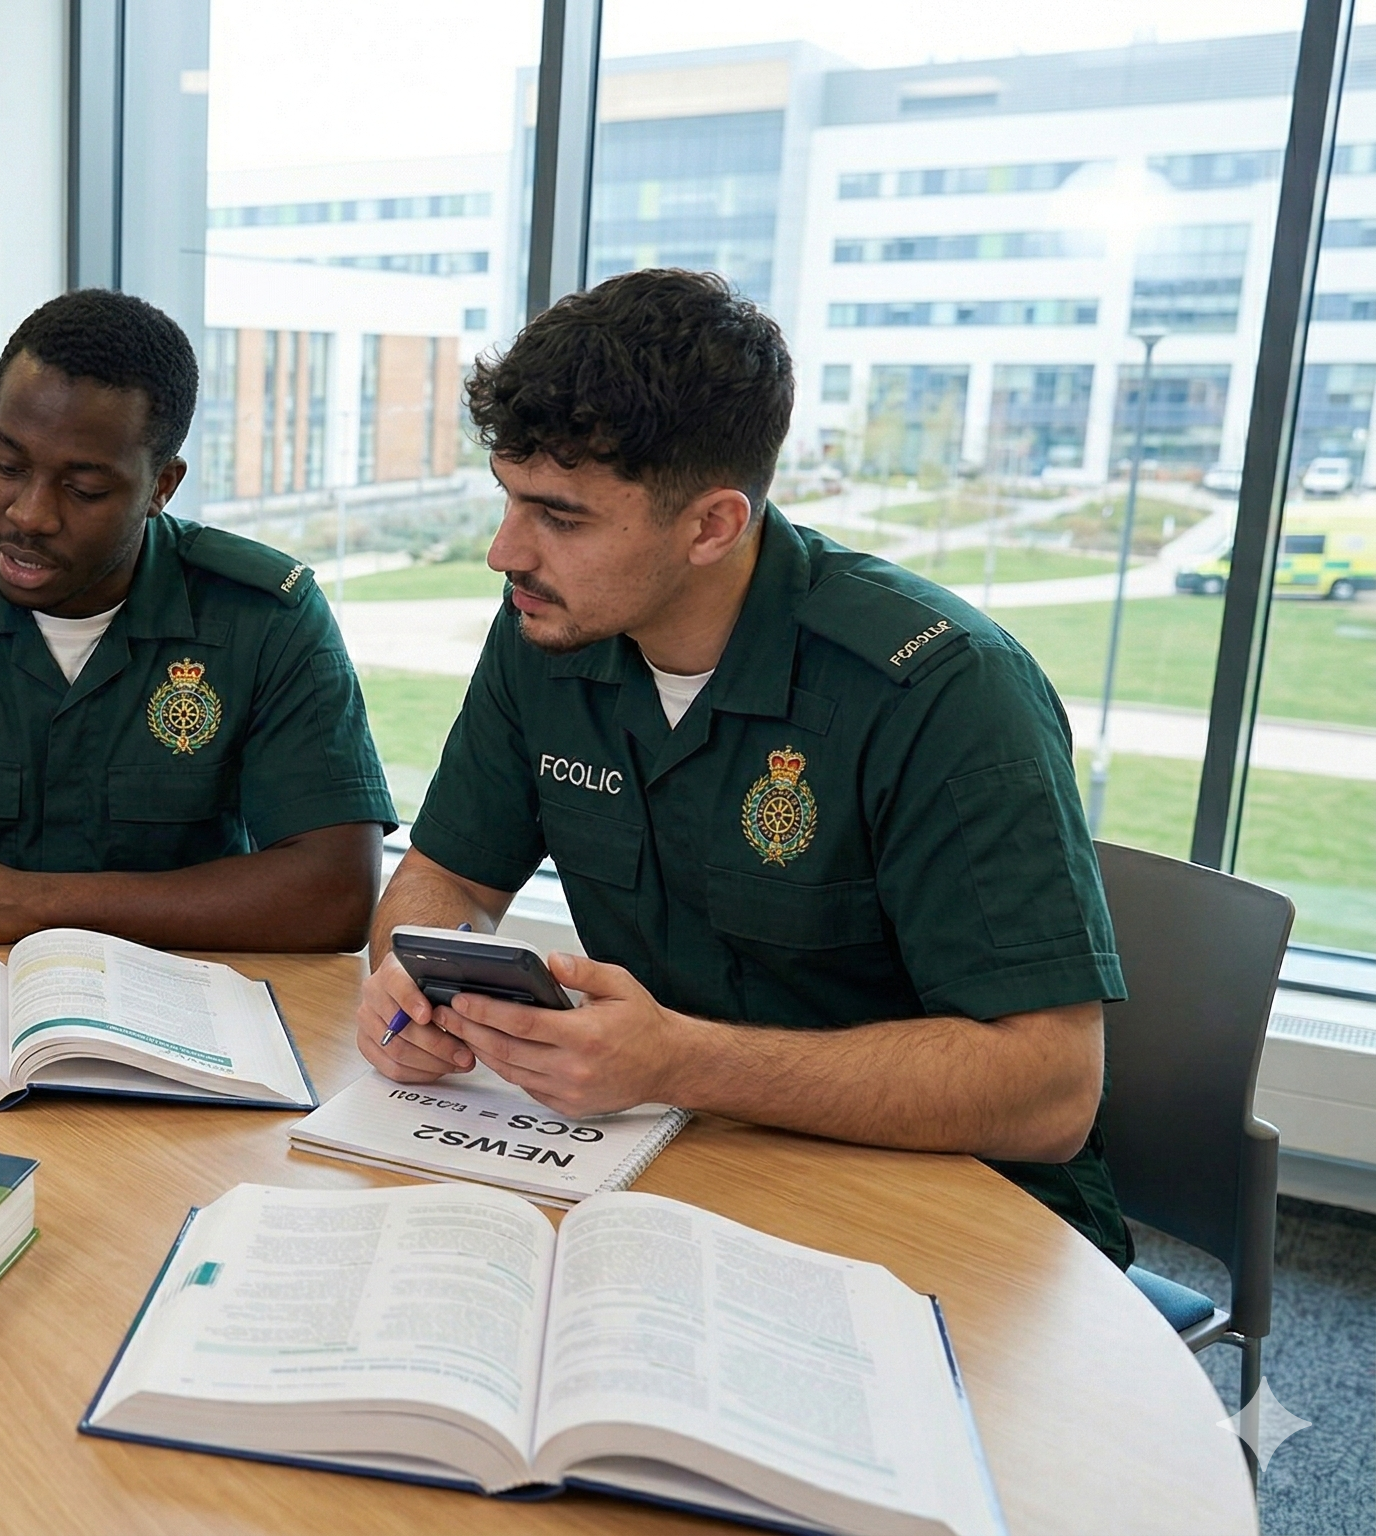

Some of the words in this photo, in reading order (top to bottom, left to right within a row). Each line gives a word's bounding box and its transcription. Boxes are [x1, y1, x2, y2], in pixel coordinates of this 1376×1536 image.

[539, 754, 623, 795] FCOLIC
[413, 1124, 575, 1168] NEWS2
[507, 1114, 605, 1143] GCS
